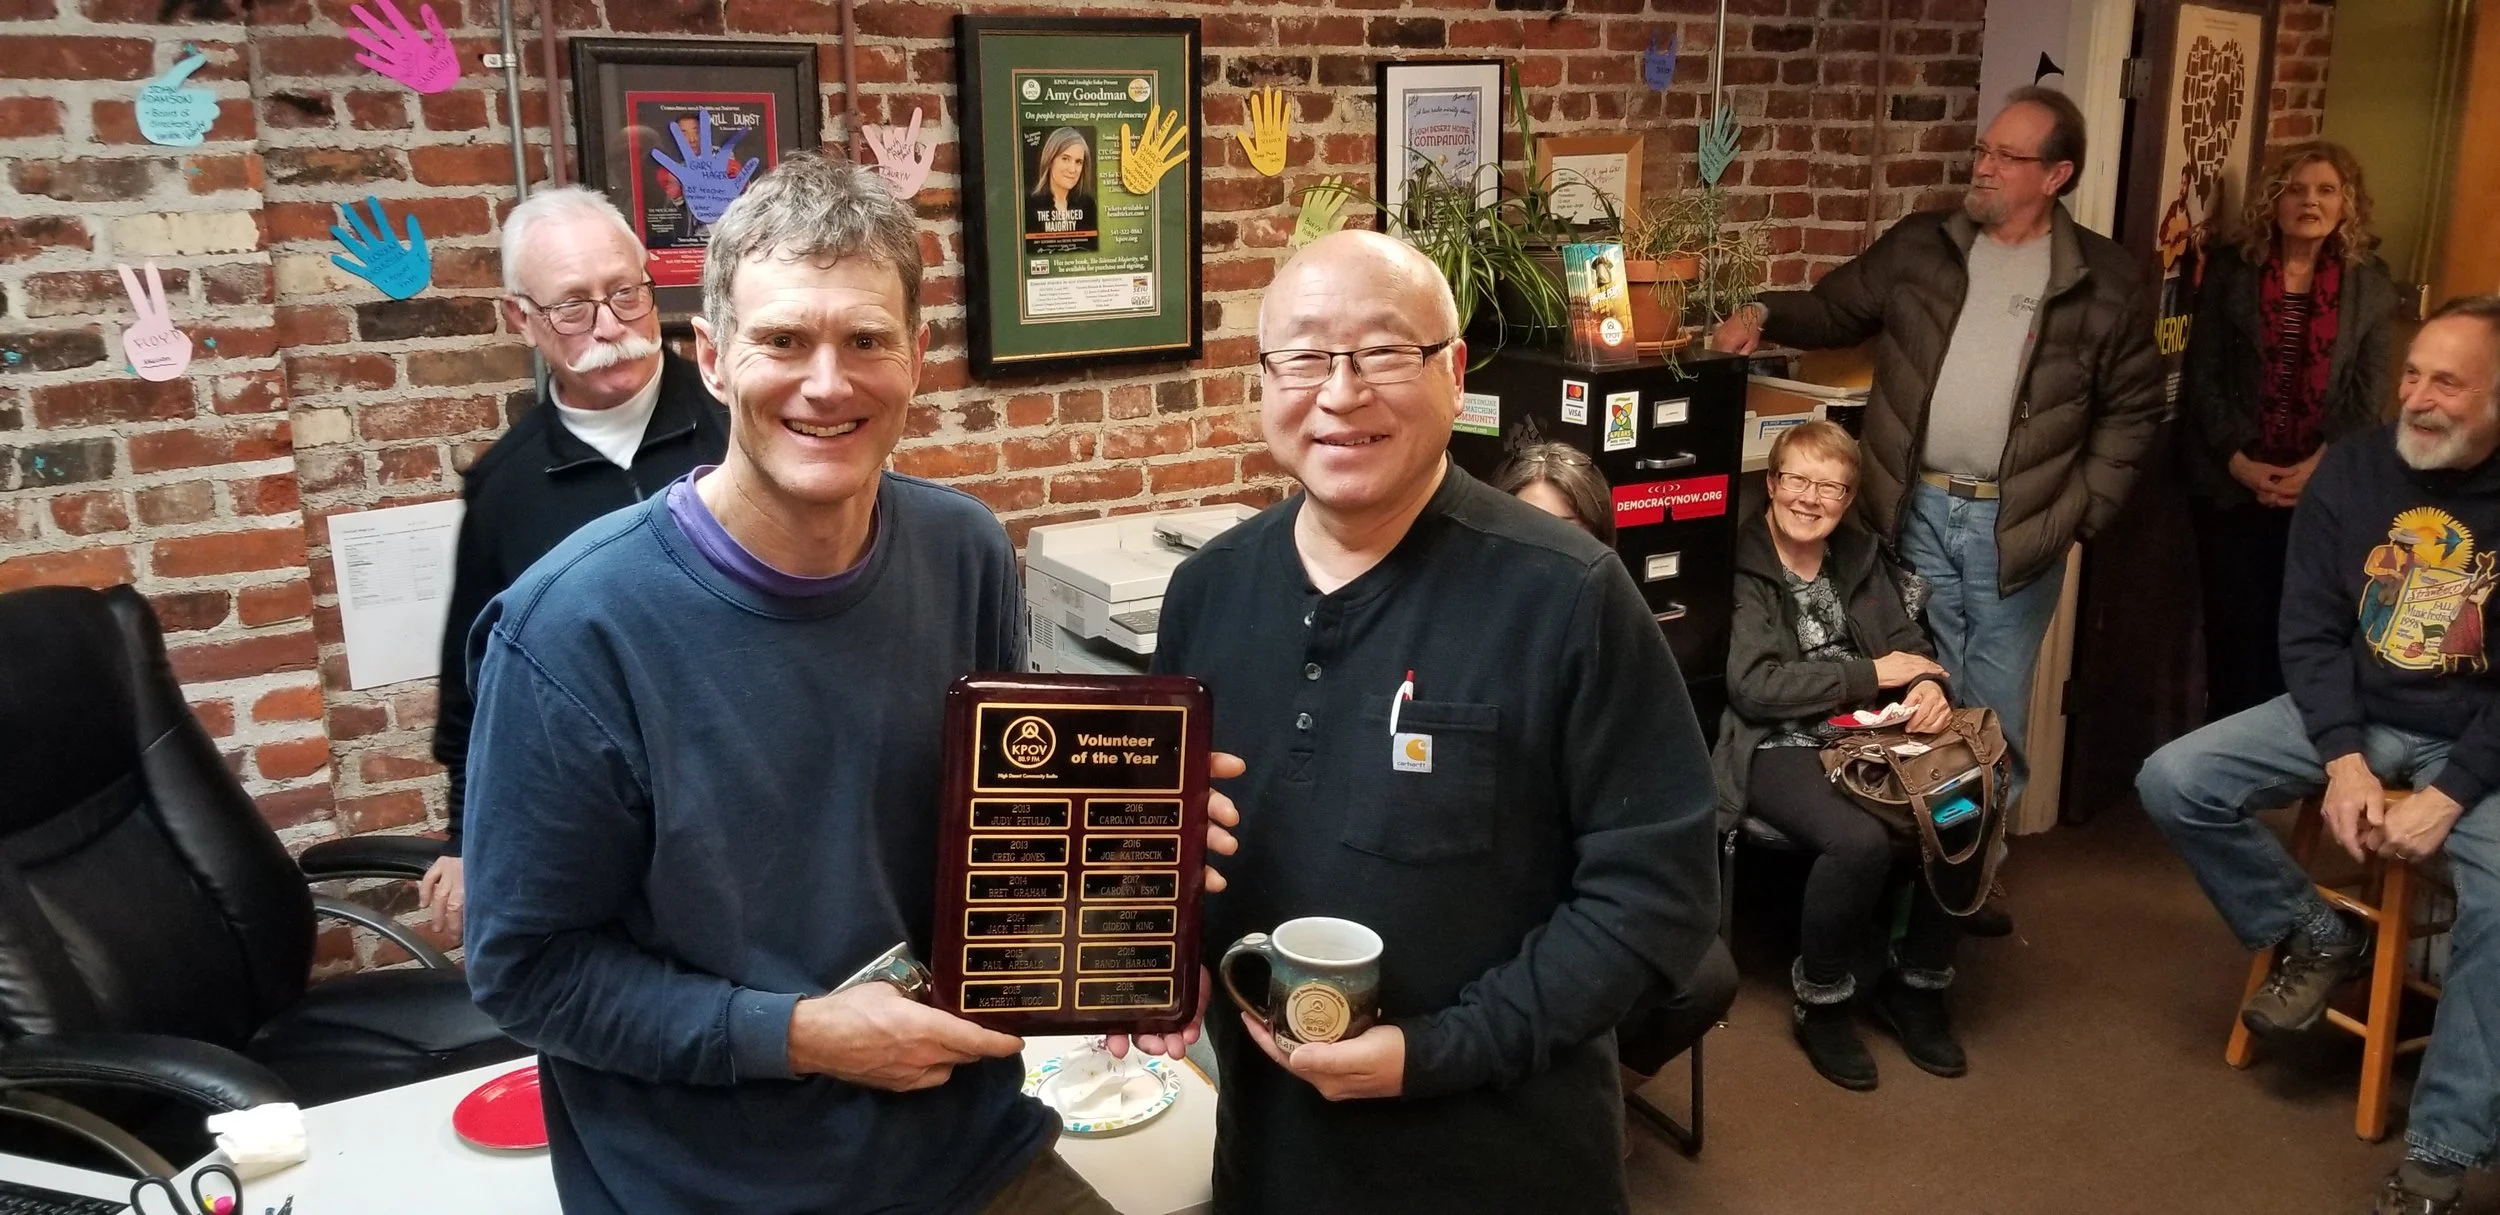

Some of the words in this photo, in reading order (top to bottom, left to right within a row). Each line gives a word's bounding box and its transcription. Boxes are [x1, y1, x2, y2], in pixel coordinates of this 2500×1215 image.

[1044, 88, 1072, 104] Amy
[1073, 88, 1127, 100] Goodman
[734, 113, 760, 126] DURST
[1036, 112, 1055, 121] people
[1056, 112, 1088, 121] organizing
[1096, 112, 1117, 120] protect
[1117, 111, 1147, 120] democracy
[1414, 134, 1470, 147] COMPANION
[1037, 211, 1050, 221] THE
[1051, 209, 1083, 221] SILENCED
[1045, 221, 1076, 232] MAJORITY
[1095, 264, 1116, 274] purchase
[1466, 406, 1497, 415] MATCHING
[1568, 409, 1581, 418] VISA
[1457, 414, 1497, 424] OMMUNITY
[1617, 490, 1722, 512] DEMOCRACYNOW.ORG
[2408, 604, 2427, 619] Music
[1077, 734, 1154, 747] Volunteer
[1012, 744, 1047, 755] KPOV
[1071, 752, 1087, 764] of
[1092, 752, 1117, 764] the
[1123, 752, 1159, 765] Year
[1012, 804, 1030, 813] 2013
[1125, 804, 1143, 813] 2016
[991, 816, 1012, 826] JUDY
[1017, 816, 1050, 825] PETULLO
[1100, 816, 1134, 824] CAROLYN
[1140, 816, 1168, 824] CLONTZ
[1010, 841, 1028, 850] 2013
[1123, 840, 1141, 848] 2016
[1020, 853, 1045, 861] JONES
[1100, 852, 1116, 860] JOE
[1009, 876, 1027, 885] 2014
[1122, 876, 1140, 884] 2017
[989, 888, 1008, 897] BRET
[1014, 888, 1047, 897] GRAHAM
[1100, 886, 1135, 896] CAROLYN
[1007, 914, 1025, 922] 2014
[1120, 911, 1138, 919] 2017
[987, 925, 1009, 934] JACK
[1103, 922, 1130, 931] GIDEON
[1136, 922, 1154, 931] KING
[1118, 947, 1135, 956] 2018
[982, 961, 1003, 970] PAUL
[1095, 960, 1121, 968] RANDY
[1126, 959, 1157, 968] HARANO
[979, 997, 1015, 1007] KATHRYN
[1100, 994, 1124, 1004] BRETT
[1277, 1036, 1295, 1051] Ran
